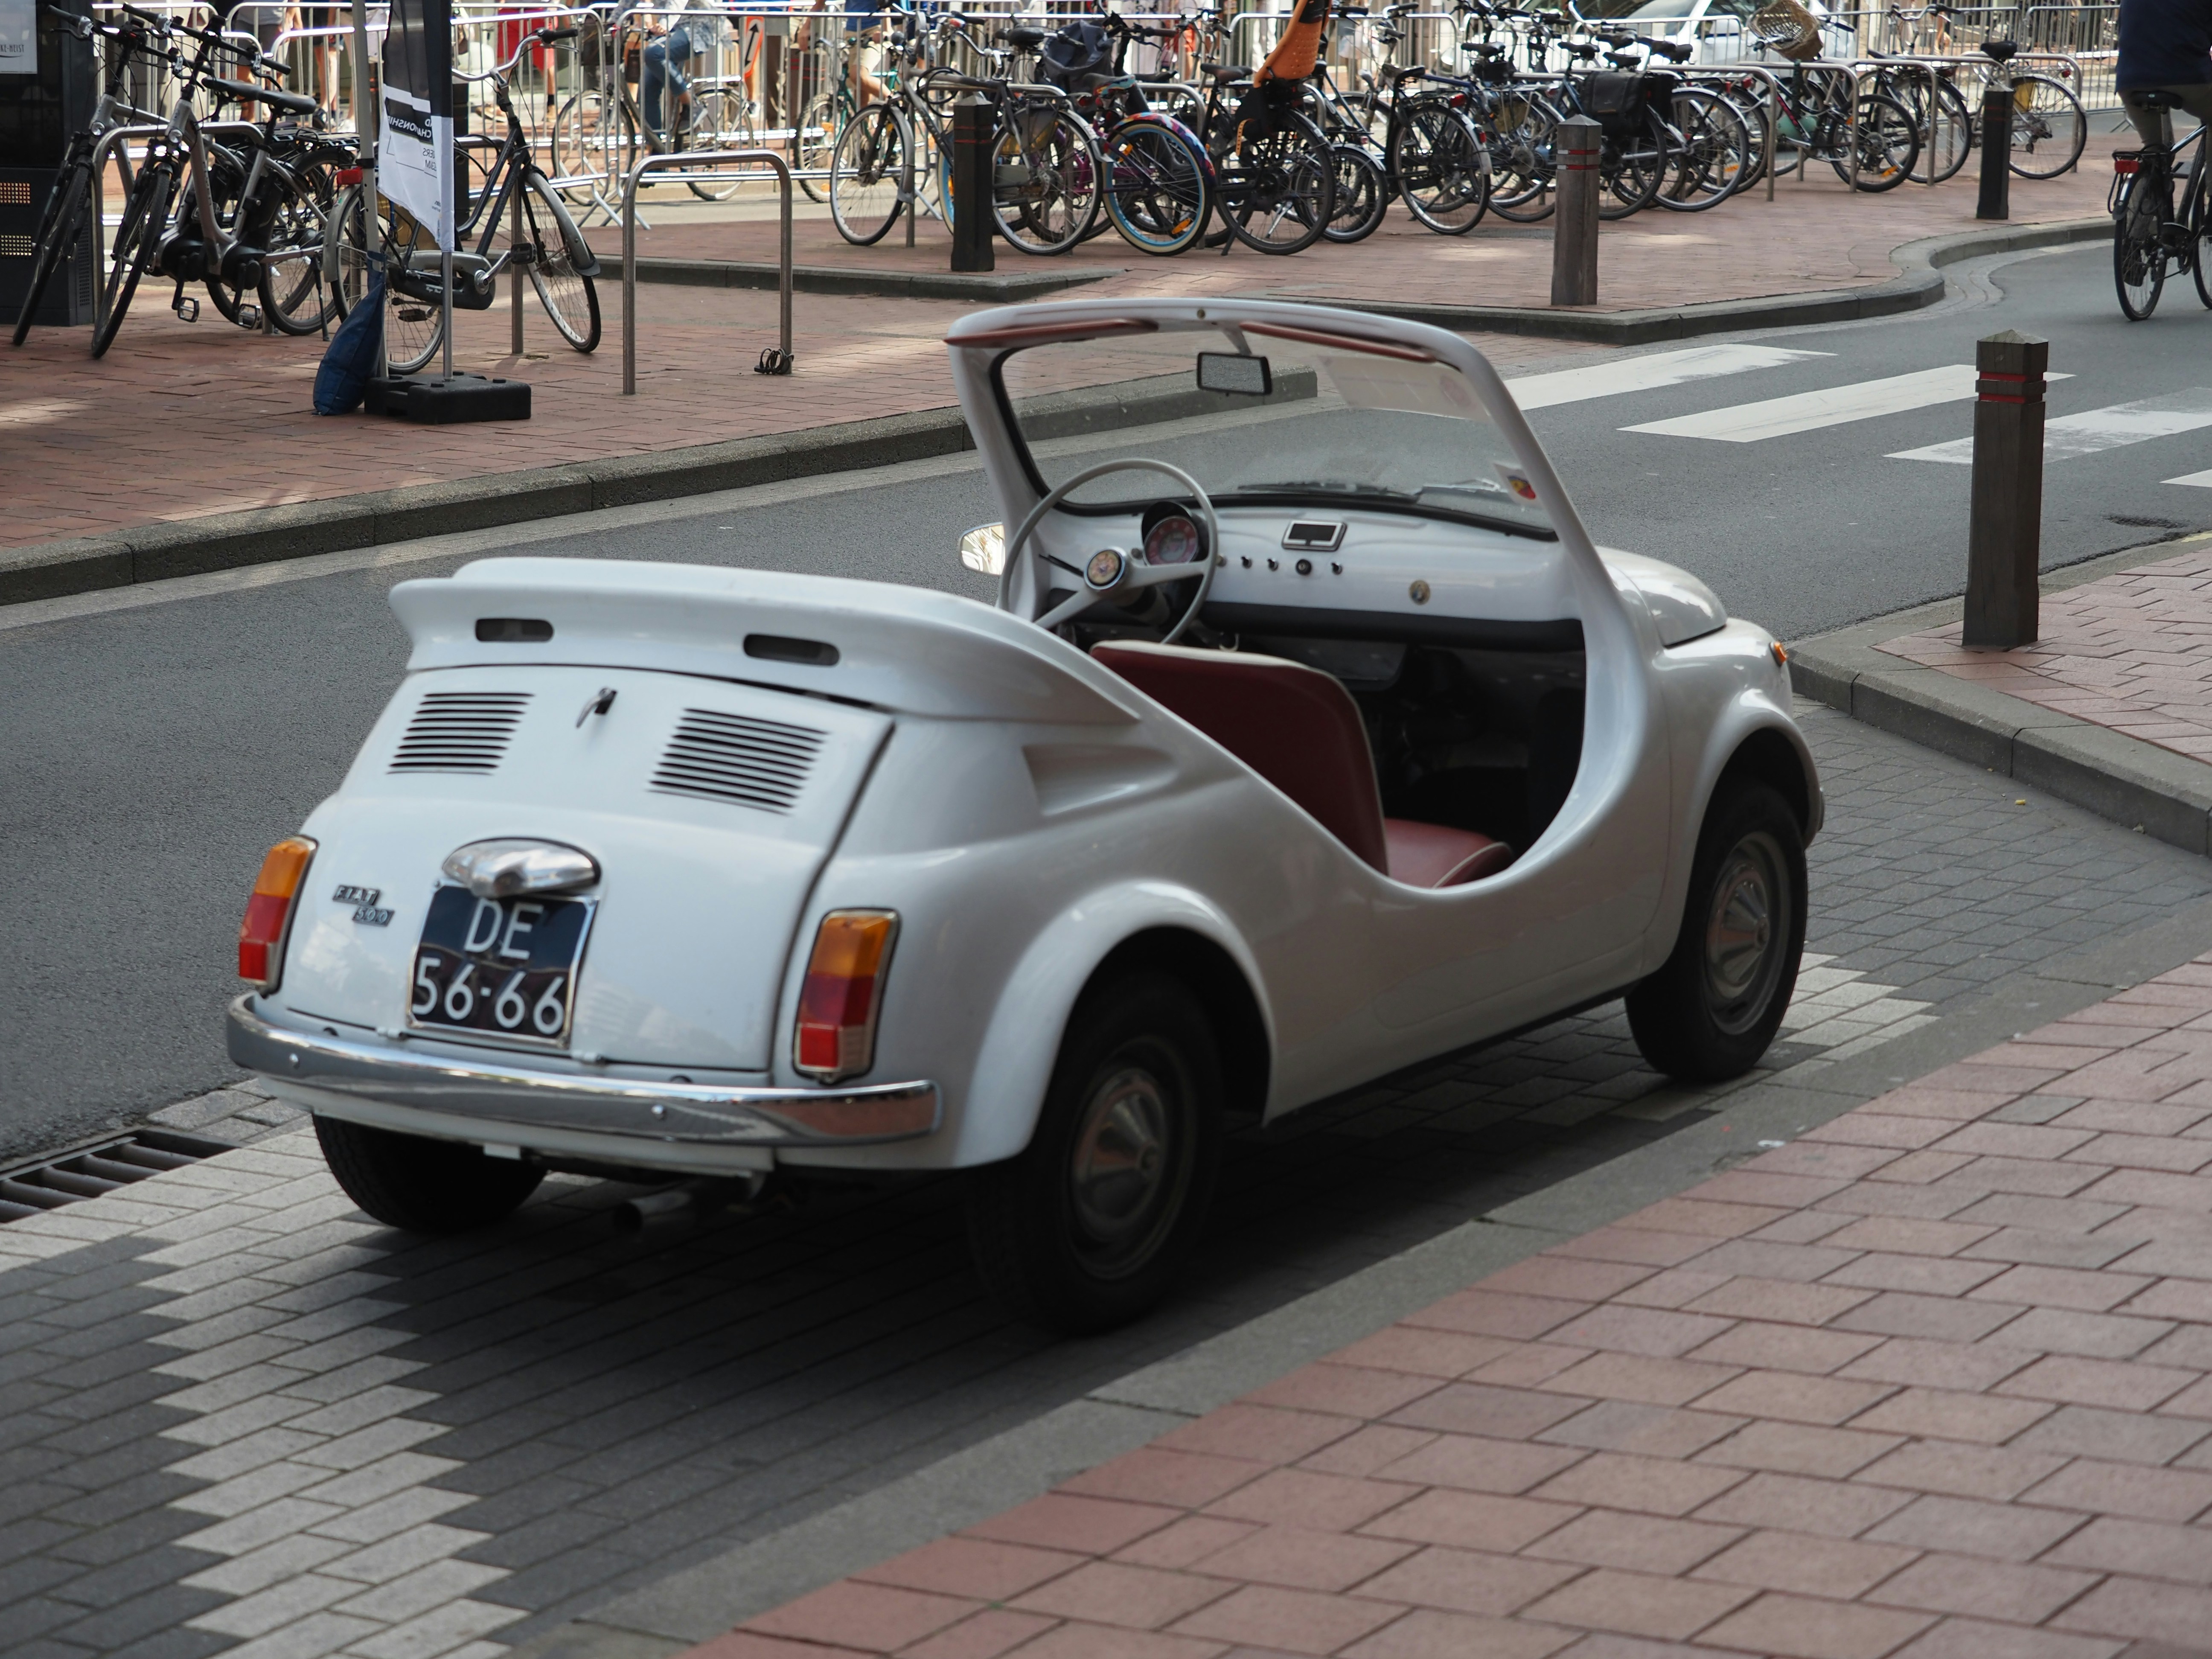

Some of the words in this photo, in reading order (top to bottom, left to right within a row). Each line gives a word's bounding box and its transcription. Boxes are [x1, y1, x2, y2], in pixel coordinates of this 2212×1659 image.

[0, 44, 24, 52] KE-HEIST
[335, 886, 376, 903] FIAT
[356, 906, 388, 924] 500
[463, 897, 544, 960] DE
[411, 956, 565, 1035] 56-66
